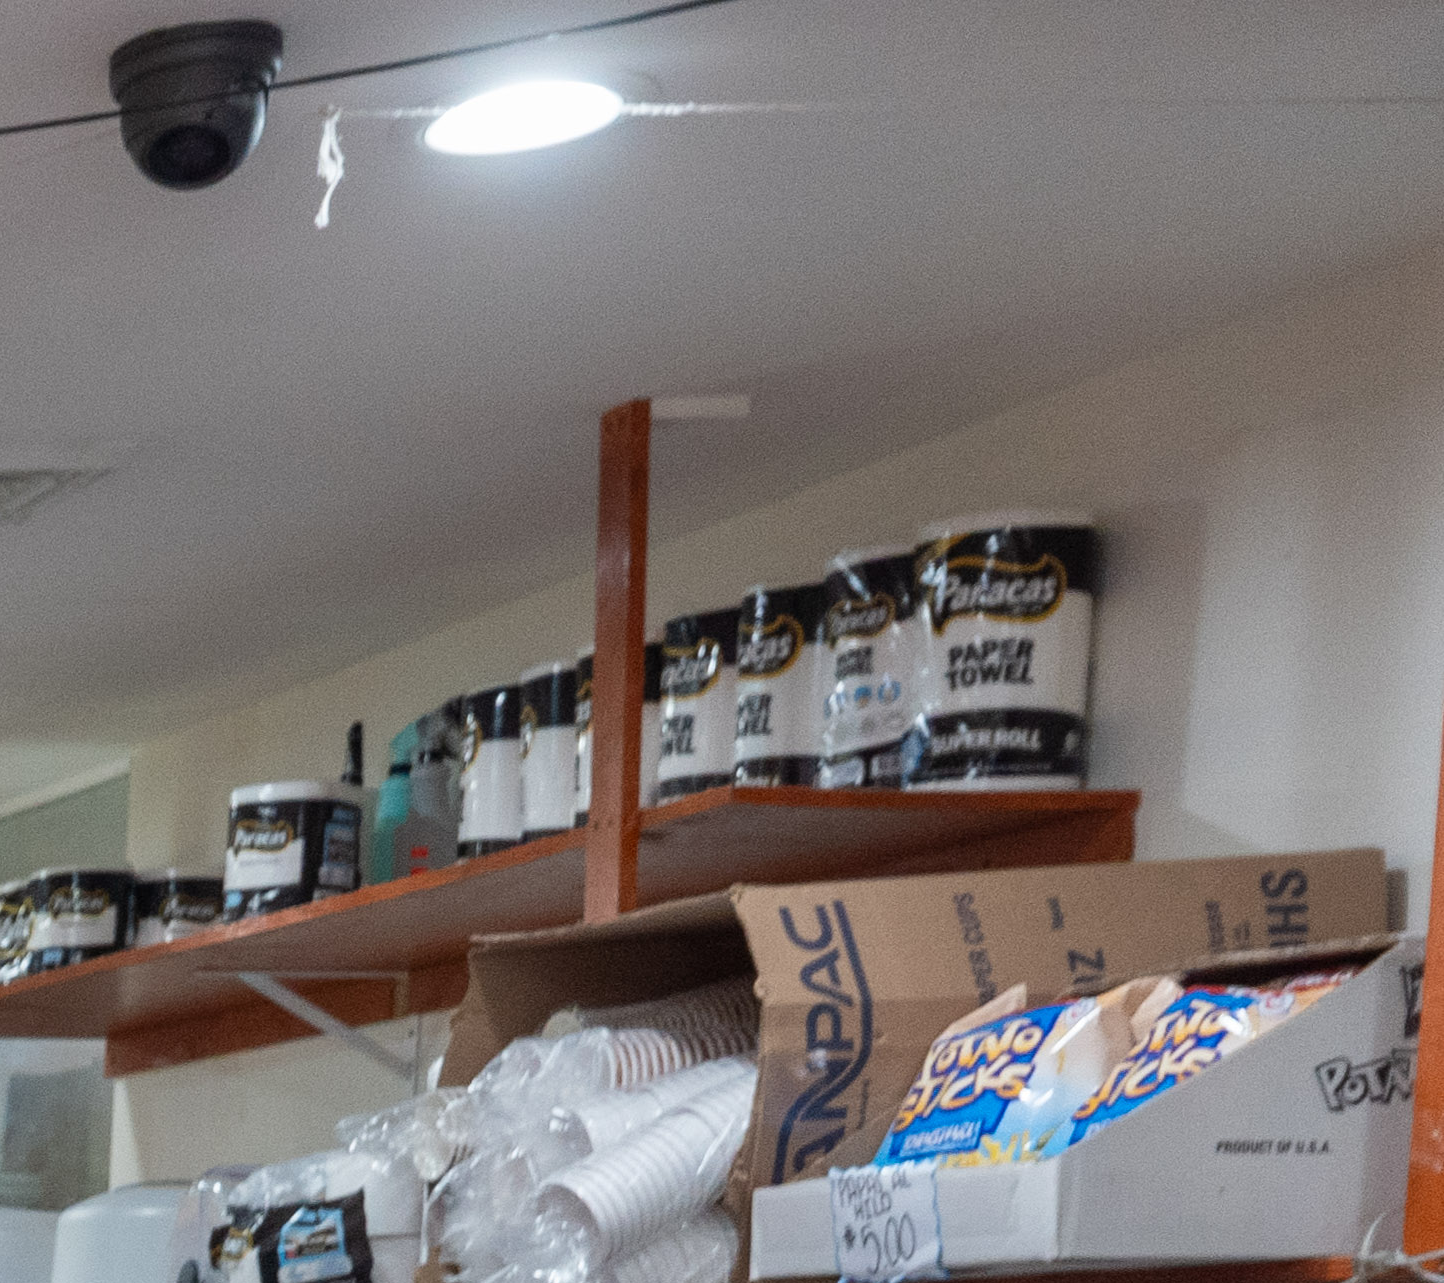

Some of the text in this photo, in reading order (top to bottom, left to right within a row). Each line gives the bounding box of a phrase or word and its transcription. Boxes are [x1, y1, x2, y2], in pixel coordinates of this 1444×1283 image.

[948, 638, 1035, 666] PAPER
[945, 661, 1034, 691] TOWEL
[1216, 1138, 1273, 1155] PRODUCT
